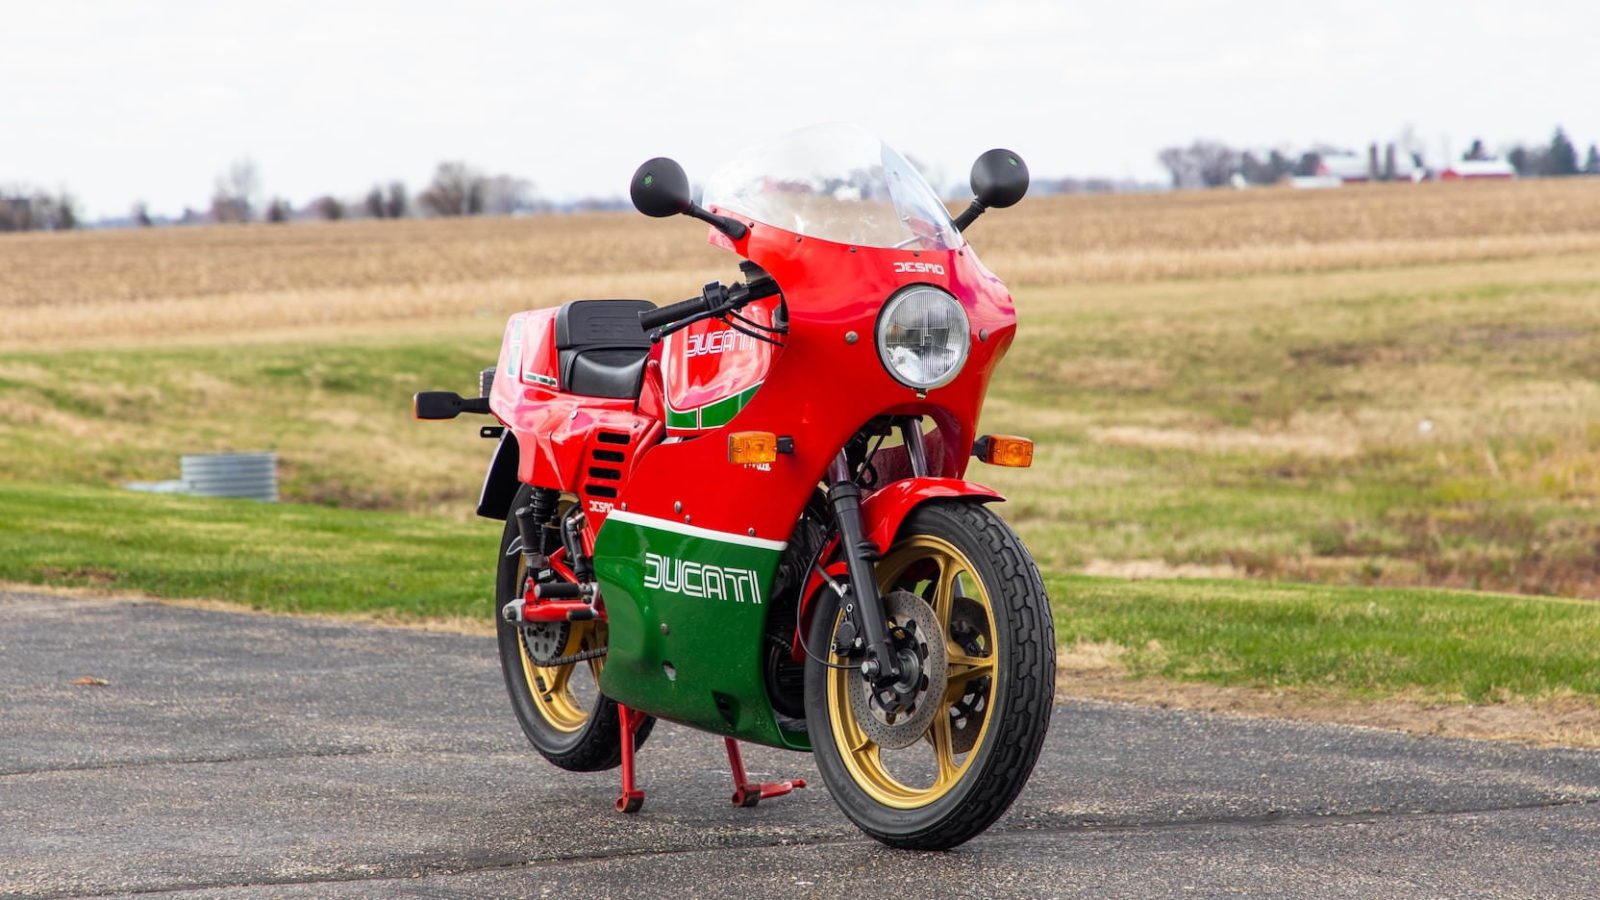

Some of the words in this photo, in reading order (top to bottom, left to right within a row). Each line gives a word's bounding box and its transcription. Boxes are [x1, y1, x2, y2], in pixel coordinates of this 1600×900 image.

[893, 262, 945, 275] DESMO
[685, 328, 757, 357] DUCATI
[644, 552, 762, 604] DUCATI
